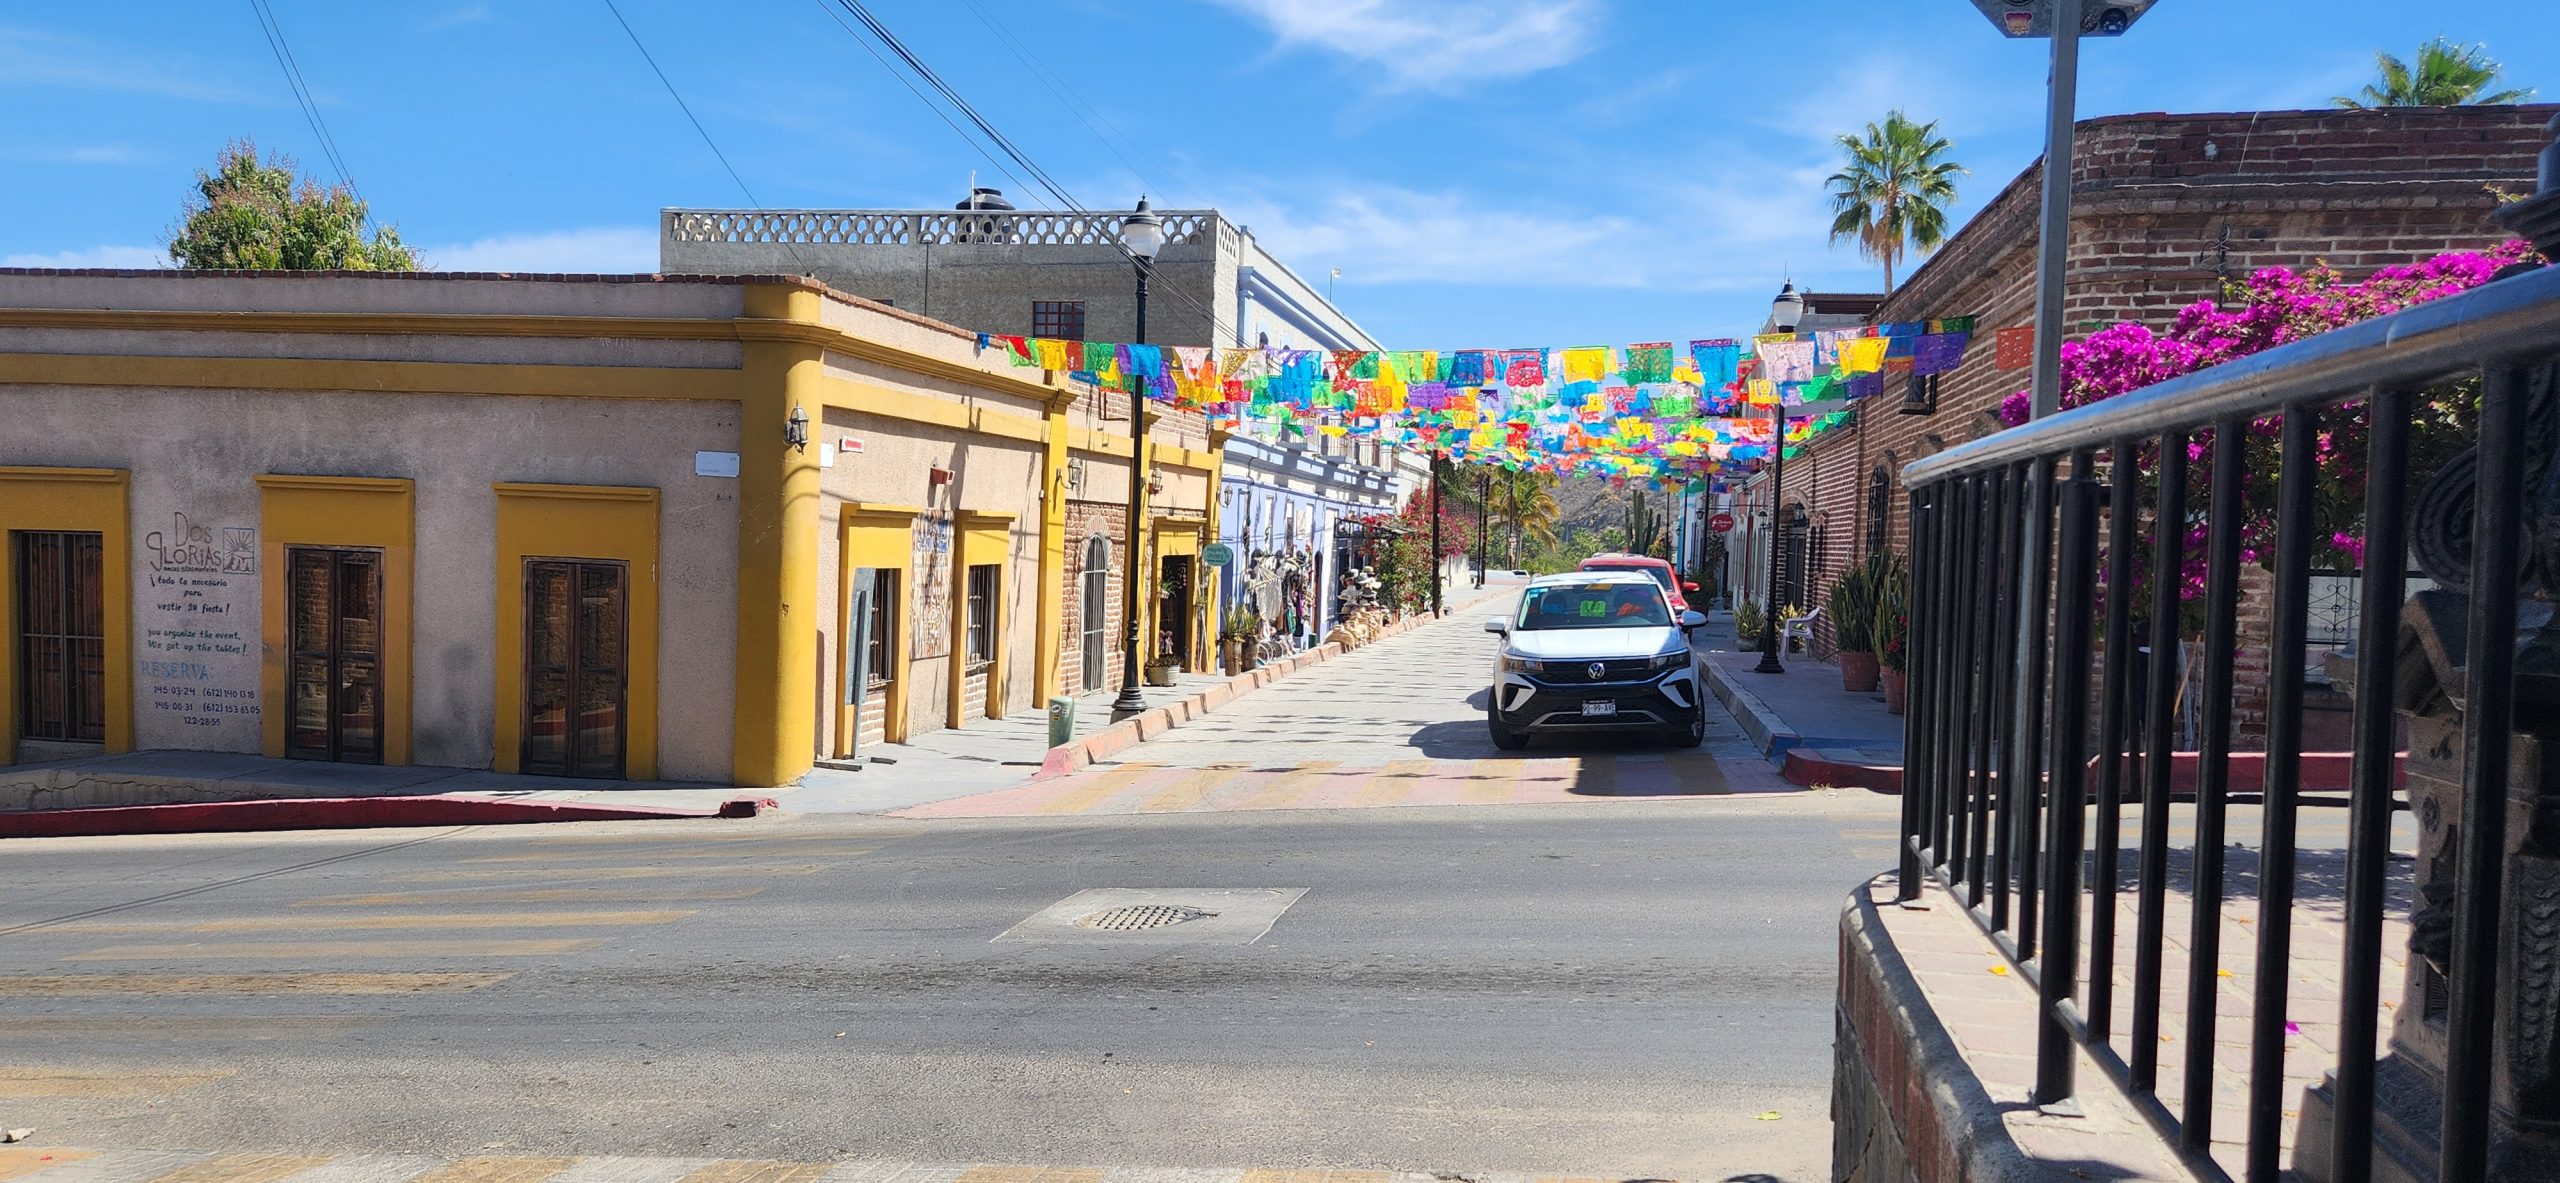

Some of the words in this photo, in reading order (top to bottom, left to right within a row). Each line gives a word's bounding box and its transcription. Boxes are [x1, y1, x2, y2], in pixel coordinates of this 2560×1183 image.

[157, 602, 182, 612] vestir
[163, 629, 196, 640] organize
[200, 630, 212, 639] the
[184, 644, 194, 652] up
[197, 644, 212, 652] the
[202, 688, 222, 698] (612)
[203, 702, 223, 712] (612)
[225, 706, 238, 714] 153
